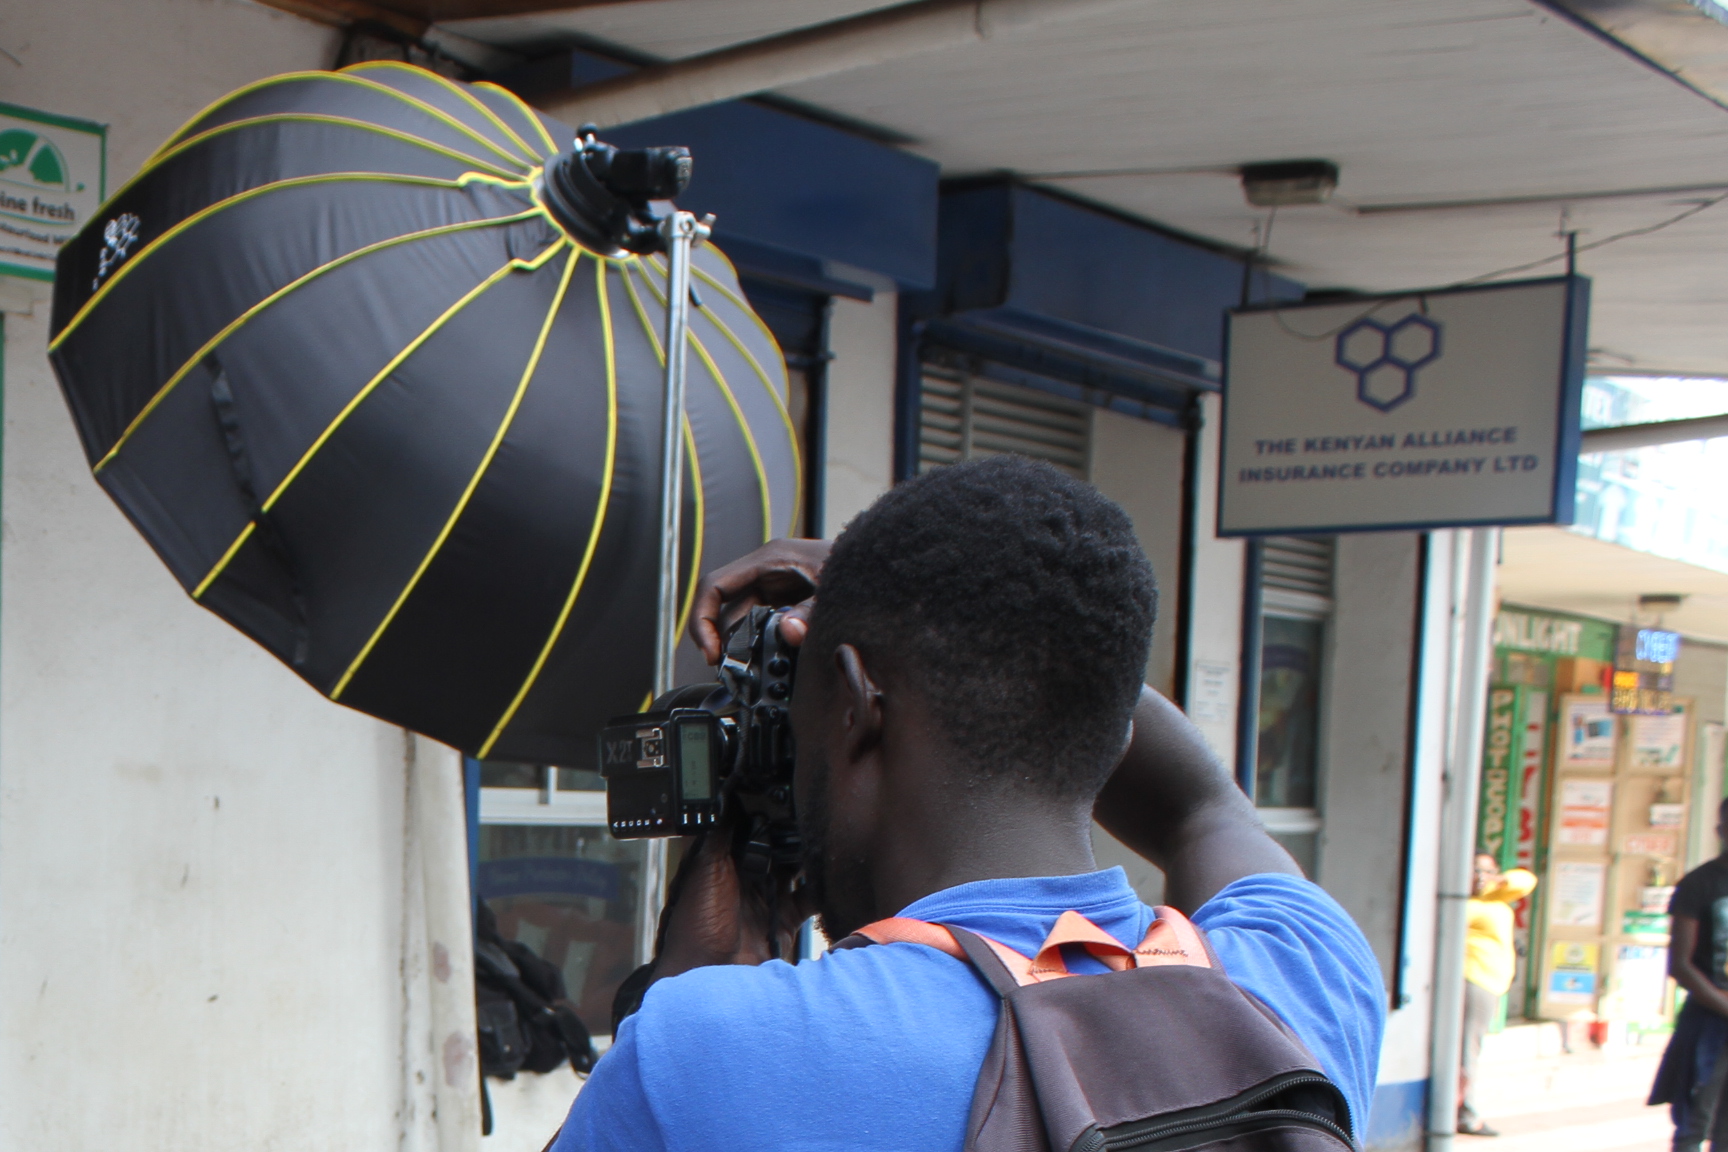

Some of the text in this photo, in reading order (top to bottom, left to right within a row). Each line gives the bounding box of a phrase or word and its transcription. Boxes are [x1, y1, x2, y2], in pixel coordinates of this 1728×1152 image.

[32, 196, 75, 221] fresh
[1255, 426, 1519, 455] THE KENYAN ALLIANCE
[1238, 454, 1540, 484] INSURANCE COMPANY LTD
